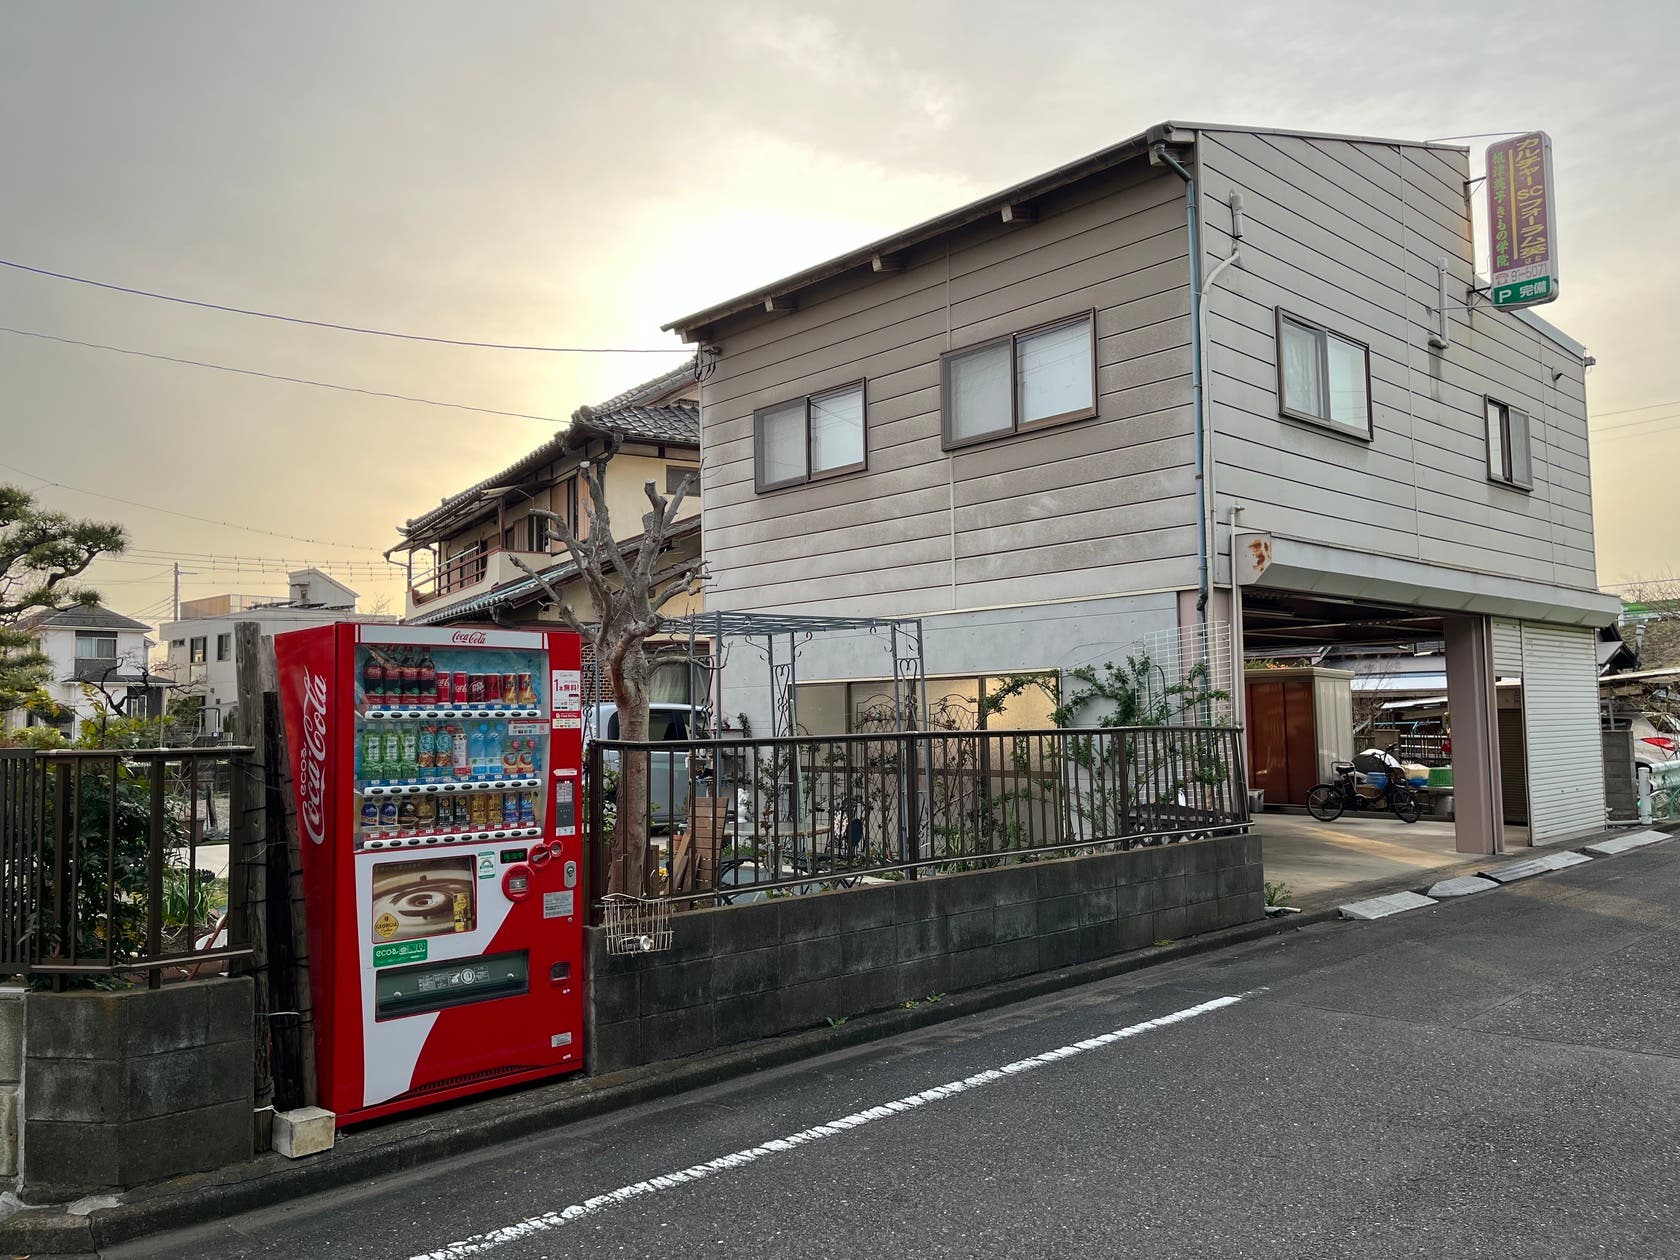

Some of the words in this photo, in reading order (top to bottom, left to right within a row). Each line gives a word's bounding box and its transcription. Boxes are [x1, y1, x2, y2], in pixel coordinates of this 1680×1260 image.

[1499, 289, 1512, 303] P
[1519, 281, 1547, 298] 完備
[302, 665, 327, 845] Coca-Cola
